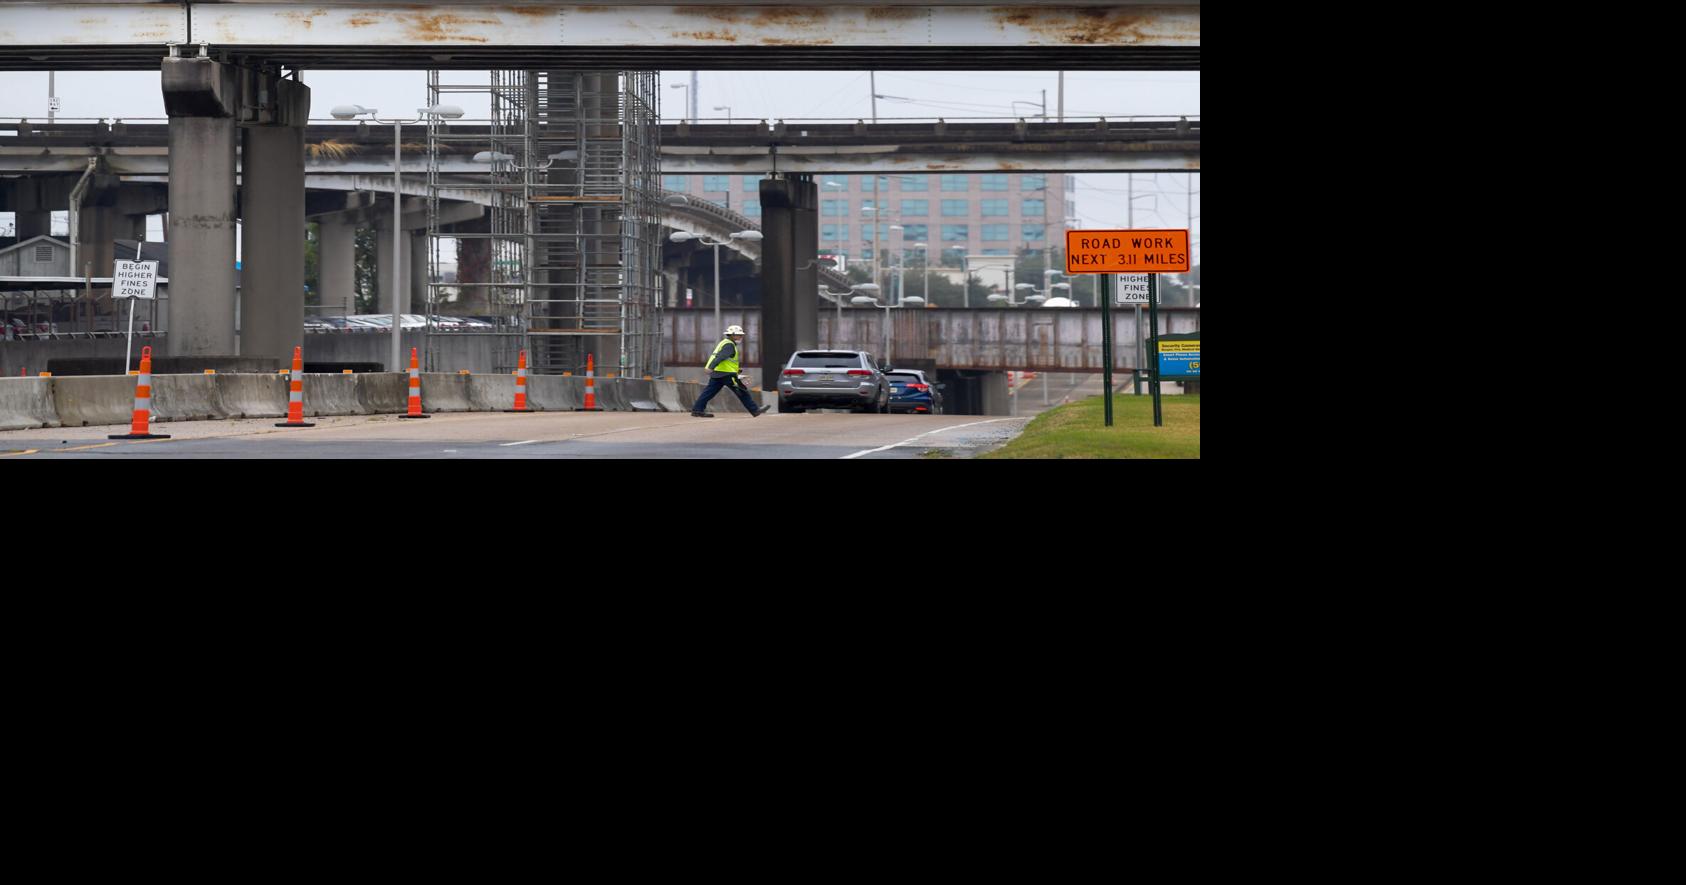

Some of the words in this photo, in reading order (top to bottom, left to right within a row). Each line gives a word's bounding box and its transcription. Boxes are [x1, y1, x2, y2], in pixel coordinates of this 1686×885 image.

[1081, 238, 1121, 249] ROAD
[1131, 238, 1174, 248] WORK
[1071, 254, 1107, 265] NEXT
[1118, 254, 1137, 265] 3.11
[1144, 253, 1185, 265] MILES
[120, 288, 146, 296] ZONE
